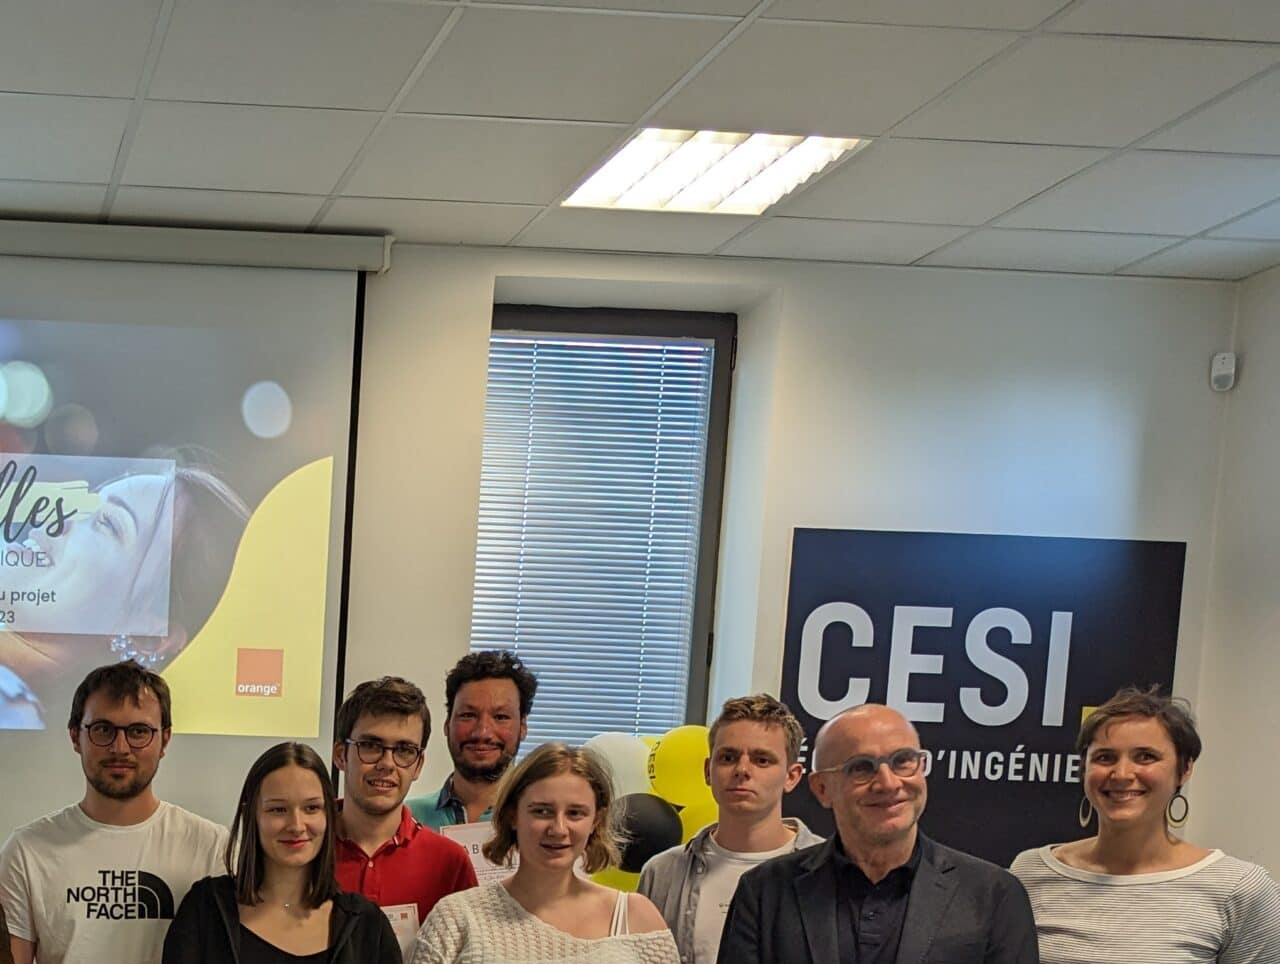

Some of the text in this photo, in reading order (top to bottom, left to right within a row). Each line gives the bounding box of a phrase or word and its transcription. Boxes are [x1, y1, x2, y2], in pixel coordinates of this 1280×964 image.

[10, 587, 56, 607] projet
[797, 601, 1073, 727] CESI
[237, 684, 278, 696] orange
[919, 744, 1081, 783] D'INGÉNIE
[98, 870, 137, 887] THE
[66, 886, 137, 903] NORTH
[86, 902, 137, 920] FACE
